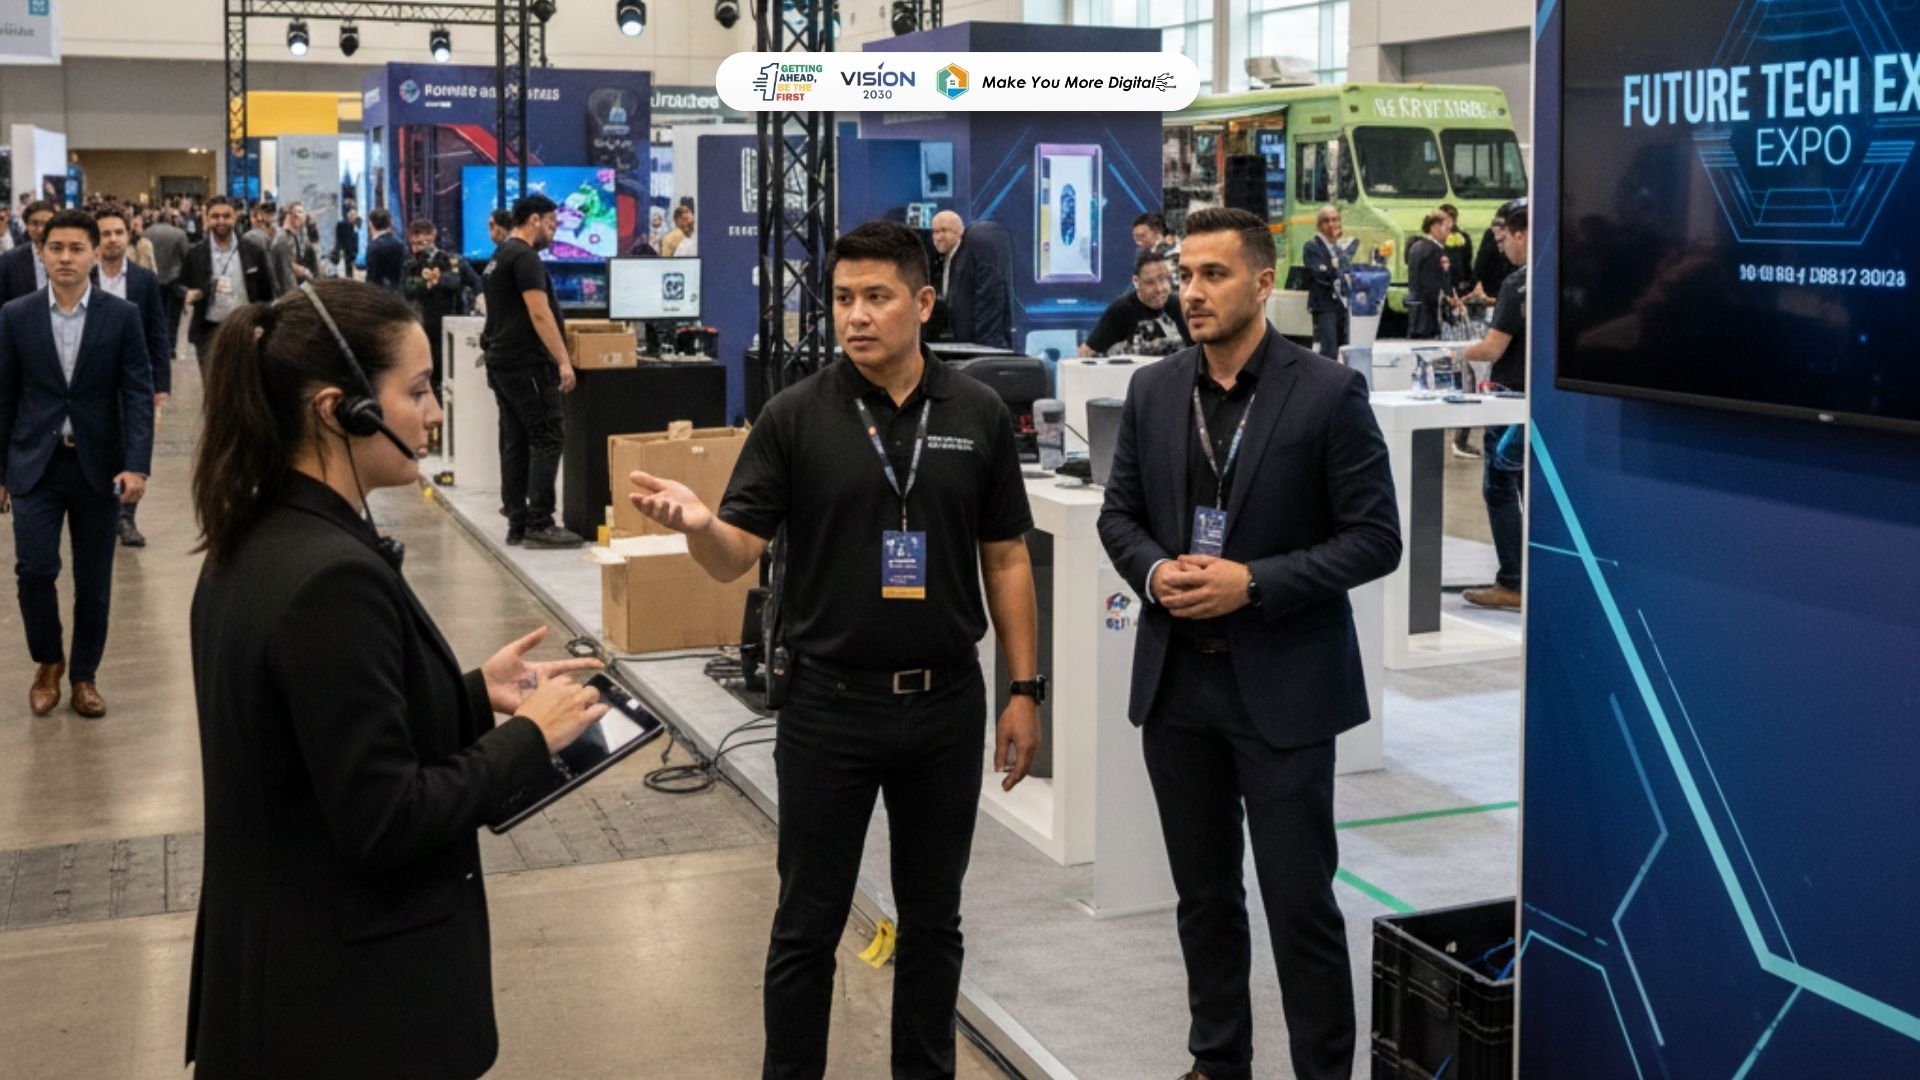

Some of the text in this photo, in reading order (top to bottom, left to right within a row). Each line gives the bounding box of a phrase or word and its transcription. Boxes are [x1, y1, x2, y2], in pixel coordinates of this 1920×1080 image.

[1623, 65, 1750, 127] FUTURE
[1760, 56, 1859, 118] TECH
[1756, 125, 1851, 166] EXPO
